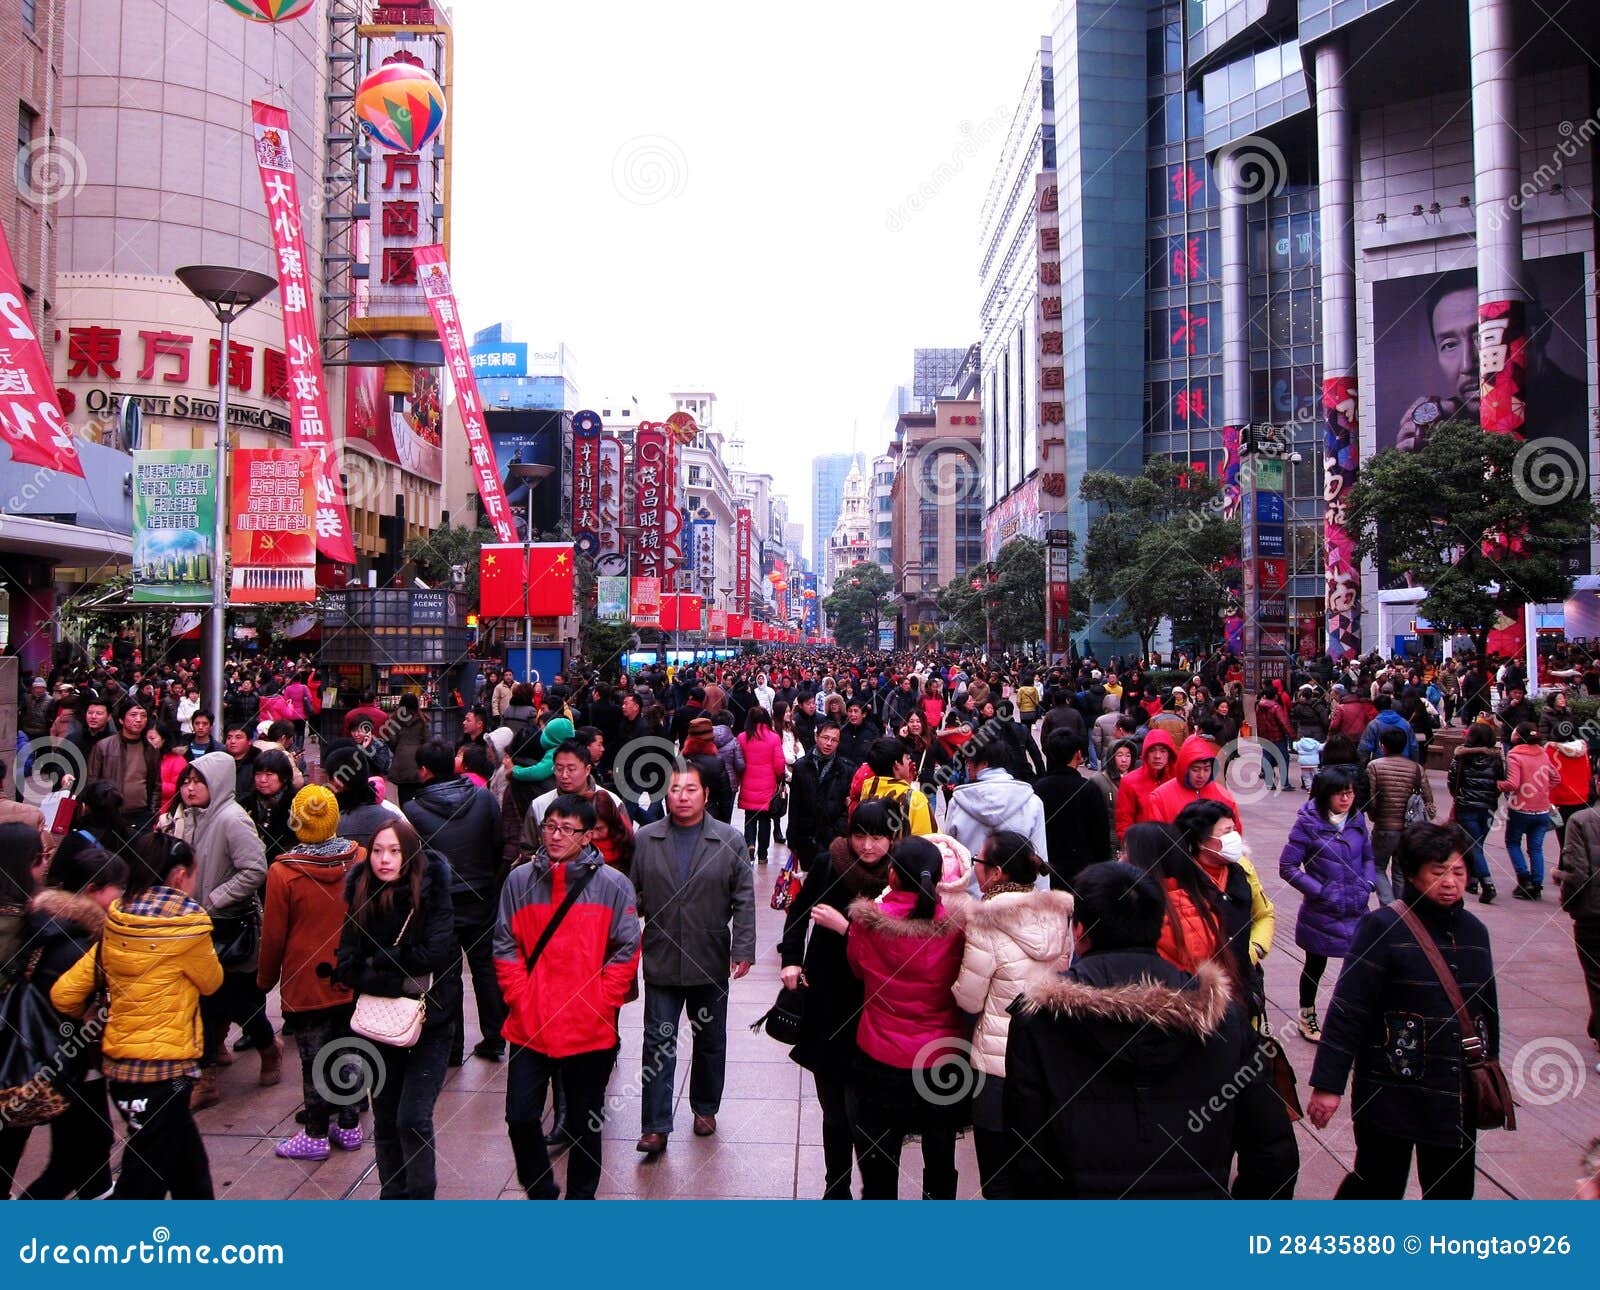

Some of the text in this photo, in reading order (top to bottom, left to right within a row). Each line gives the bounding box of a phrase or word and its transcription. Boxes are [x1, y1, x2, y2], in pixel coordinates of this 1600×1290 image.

[174, 395, 260, 424] SHOPING
[640, 466, 661, 579] 茂昌眼镜公司
